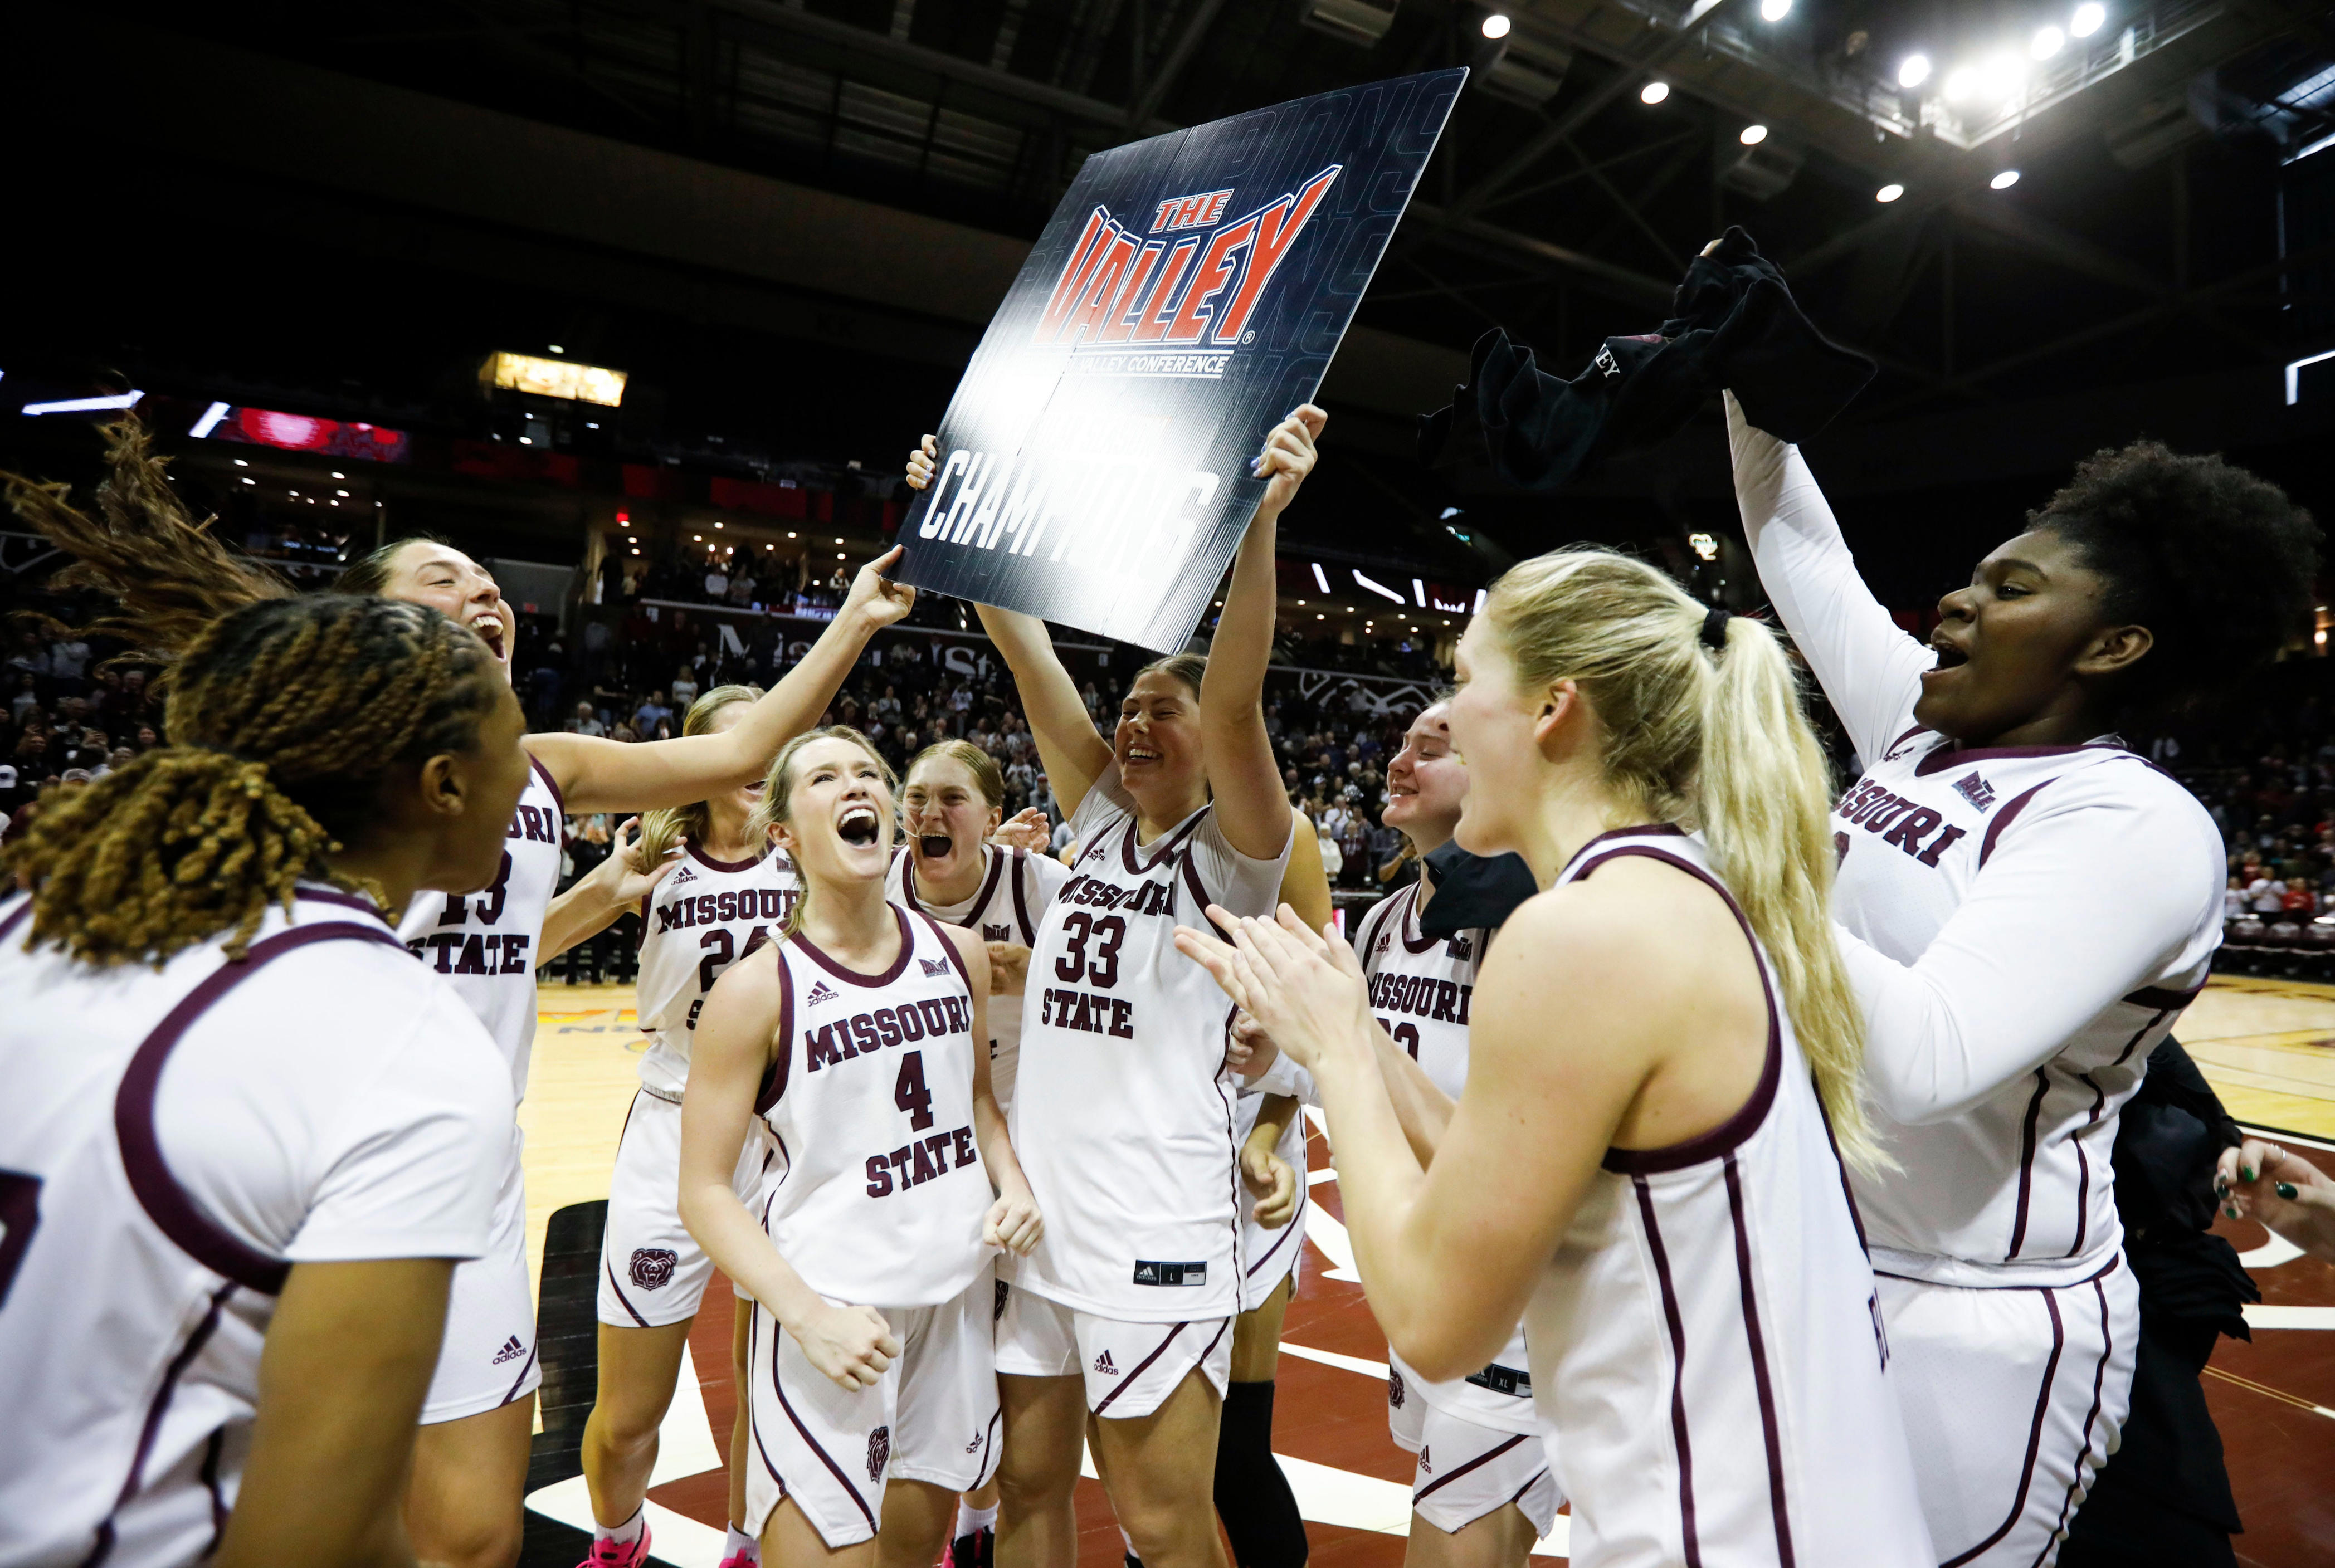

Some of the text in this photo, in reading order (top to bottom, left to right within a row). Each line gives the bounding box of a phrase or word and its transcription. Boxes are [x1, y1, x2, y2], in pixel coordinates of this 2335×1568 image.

[1154, 188, 1235, 232] THE
[1034, 164, 1343, 349] VALLEY
[1127, 355, 1231, 374] CONFERENCE
[919, 449, 1220, 582] CHAMPIONS
[1839, 778, 1967, 869] SSOURI
[671, 875, 698, 886] adidas
[656, 888, 800, 935] MISSOUR
[1055, 911, 1127, 989] 33
[805, 995, 969, 1073] MISSOURI
[1042, 988, 1134, 1039] STATE
[894, 1050, 934, 1132] 4
[866, 1125, 977, 1199] STATE
[493, 1347, 527, 1365] adidas
[1094, 1363, 1119, 1376] adidas
[1498, 1378, 1508, 1388] XL
